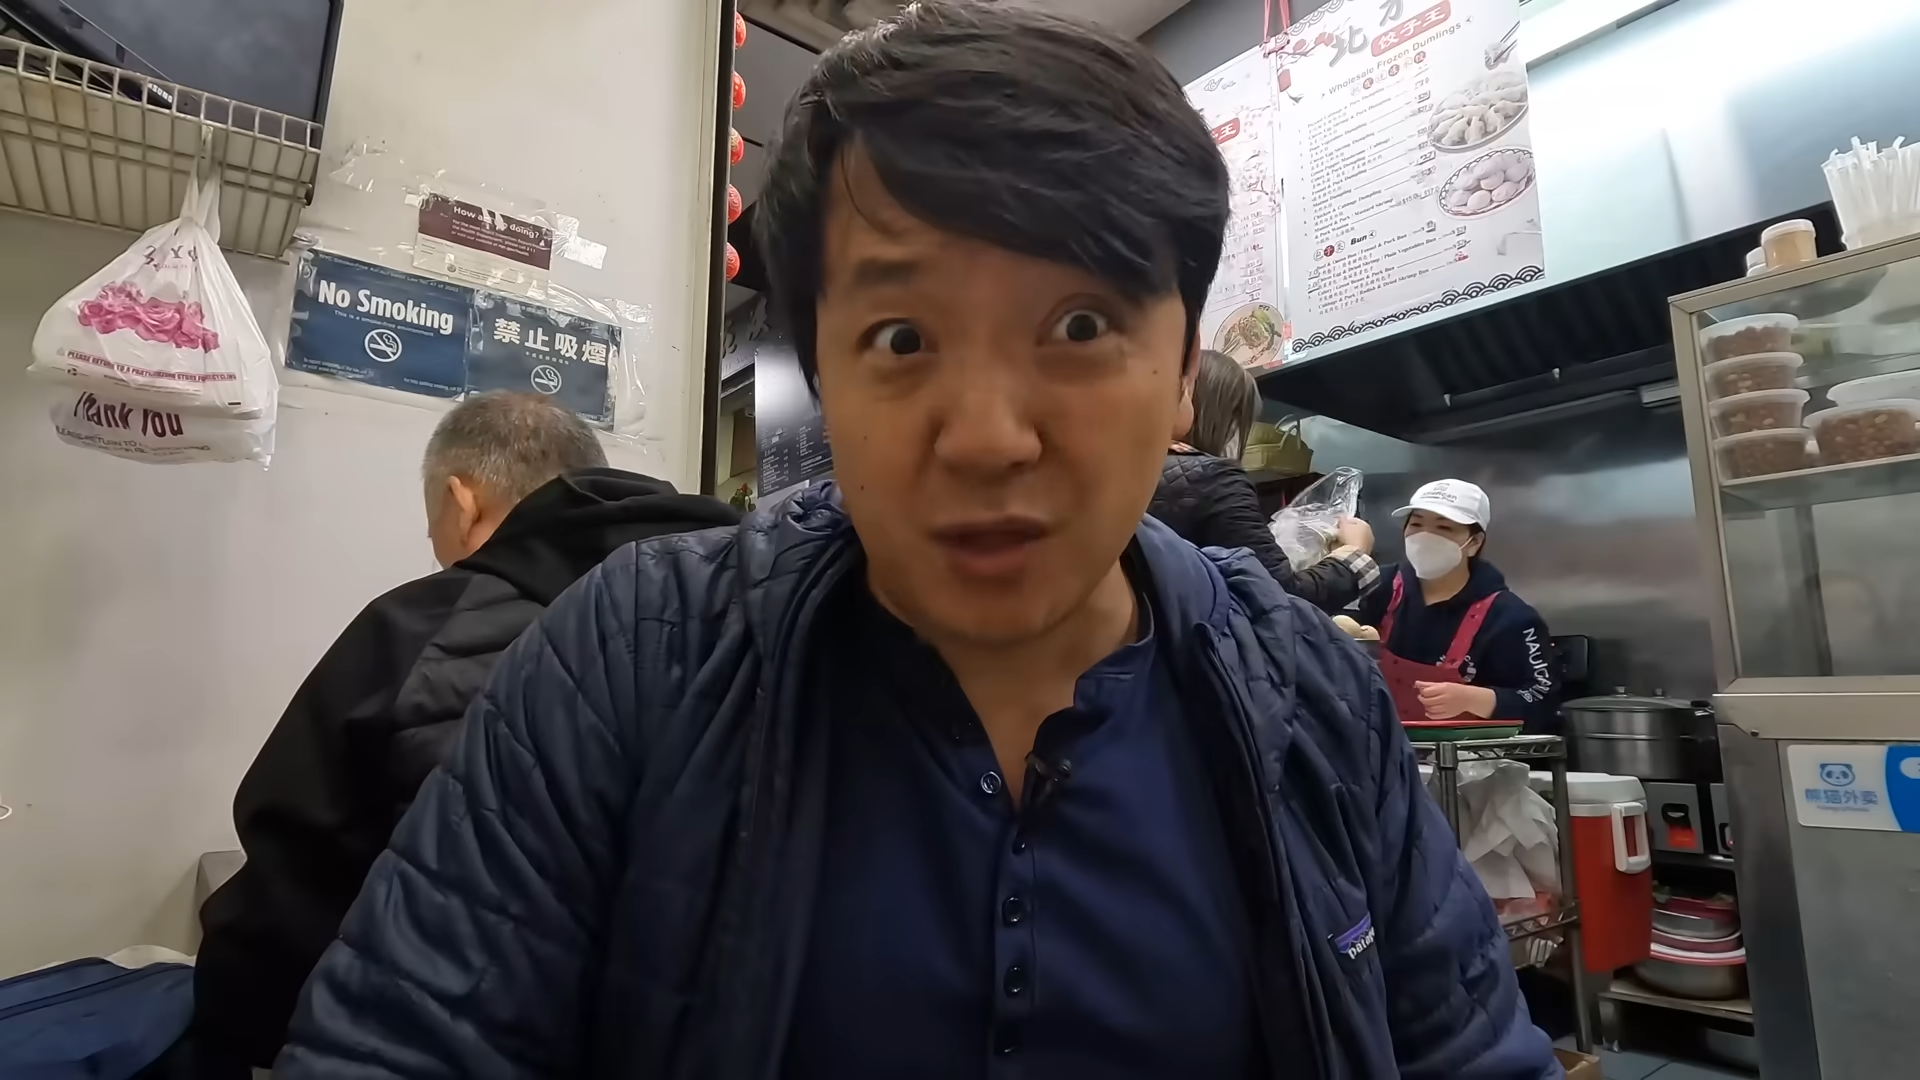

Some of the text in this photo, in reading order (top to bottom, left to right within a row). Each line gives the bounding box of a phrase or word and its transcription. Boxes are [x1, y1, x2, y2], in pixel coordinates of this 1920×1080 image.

[1412, 23, 1462, 51] Dumlings
[453, 205, 540, 239] How doing?
[1350, 234, 1368, 246] Bun
[318, 280, 454, 335] No Smoking
[493, 318, 607, 366] 禁止吸煙
